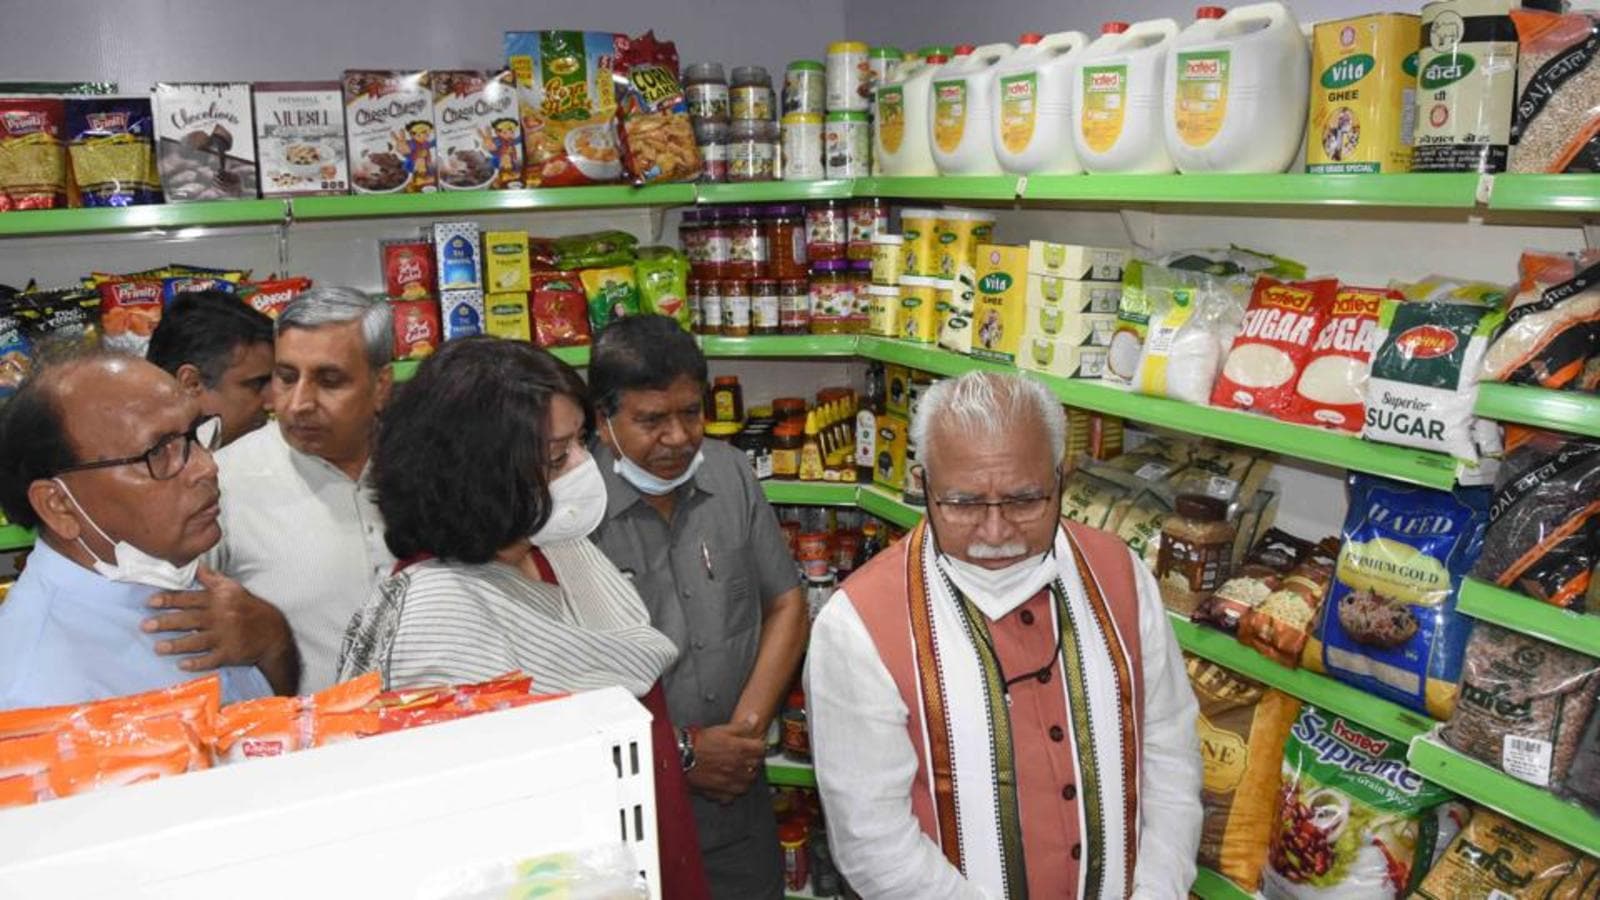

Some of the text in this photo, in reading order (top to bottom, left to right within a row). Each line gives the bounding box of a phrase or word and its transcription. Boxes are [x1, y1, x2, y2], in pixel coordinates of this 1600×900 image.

[1332, 61, 1364, 81] Vita
[1328, 90, 1359, 102] GHEE
[985, 274, 1006, 290] Vita
[1241, 309, 1315, 347] SUGAR
[1381, 391, 1432, 412] Superior
[1367, 407, 1446, 441] SUGAR
[1398, 565, 1440, 585] GOLD
